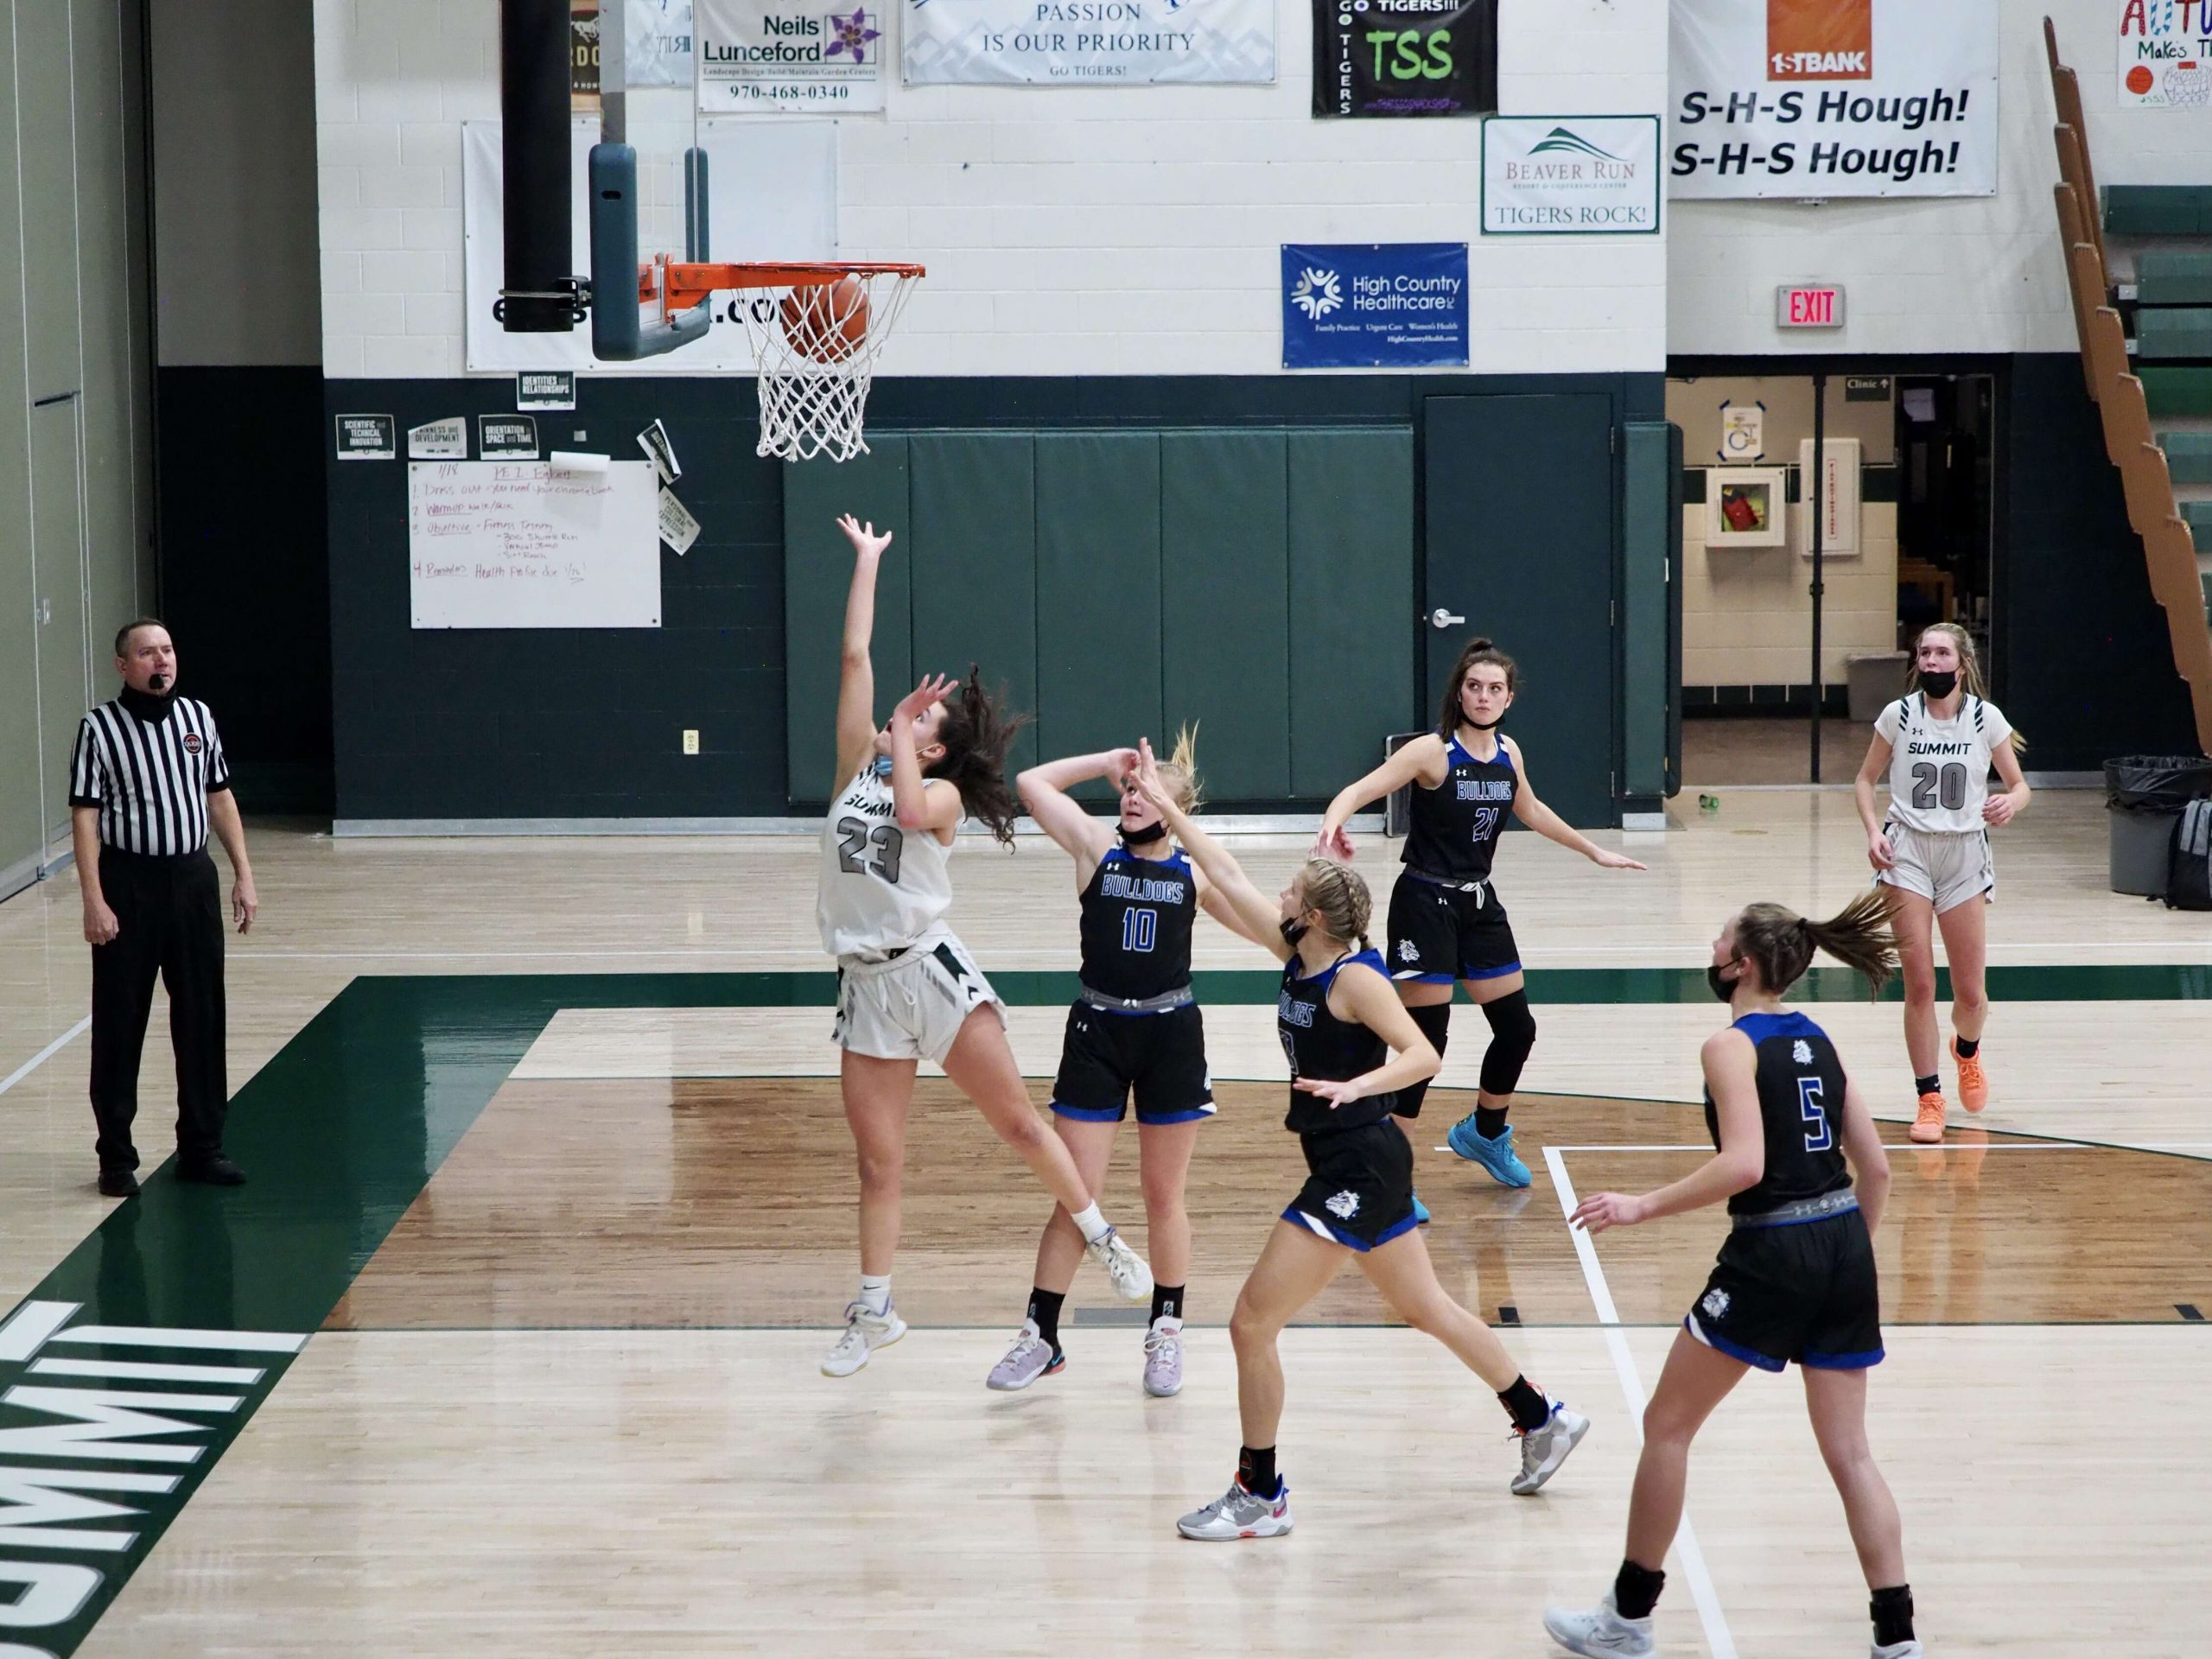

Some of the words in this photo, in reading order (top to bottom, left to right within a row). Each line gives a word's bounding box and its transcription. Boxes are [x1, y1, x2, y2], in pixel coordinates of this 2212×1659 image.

[1036, 3, 1142, 22] PASSION
[764, 15, 819, 36] Neils
[703, 41, 820, 61] Lunceford
[983, 34, 1005, 52] IS
[1014, 34, 1067, 52] OUR
[1077, 33, 1196, 52] PRIORITY
[1365, 29, 1453, 81] TSS
[1049, 65, 1070, 77] GO
[1073, 65, 1127, 77] TIGERS!
[1338, 34, 1352, 114] TIGERS
[730, 85, 849, 99] 970-468-0340
[1679, 91, 1804, 124] S-H-S
[1816, 88, 1970, 130] Hough!
[1506, 162, 1583, 180] BEAVER
[1593, 162, 1635, 180] RUN
[1670, 143, 1797, 176] S-H-S
[1808, 141, 1960, 182] Hough!
[1495, 206, 1573, 225] TIGERS
[1580, 206, 1646, 224] ROCK!
[1353, 276, 1390, 296] High
[1395, 275, 1461, 295] Country
[1353, 294, 1446, 311] Healthcare
[1789, 291, 1835, 323] EXIT
[1847, 378, 1878, 389] Clinic
[415, 434, 461, 442] DEVELOPMENT
[1908, 742, 1973, 755] SUMMIT
[1456, 780, 1513, 800] BULLDOGS
[1911, 761, 1967, 810] 20
[1472, 807, 1499, 842] 21
[836, 816, 904, 885] 23
[1101, 874, 1185, 905] BULLDOGS
[1122, 906, 1158, 952] 10
[1797, 1077, 1832, 1153] 5
